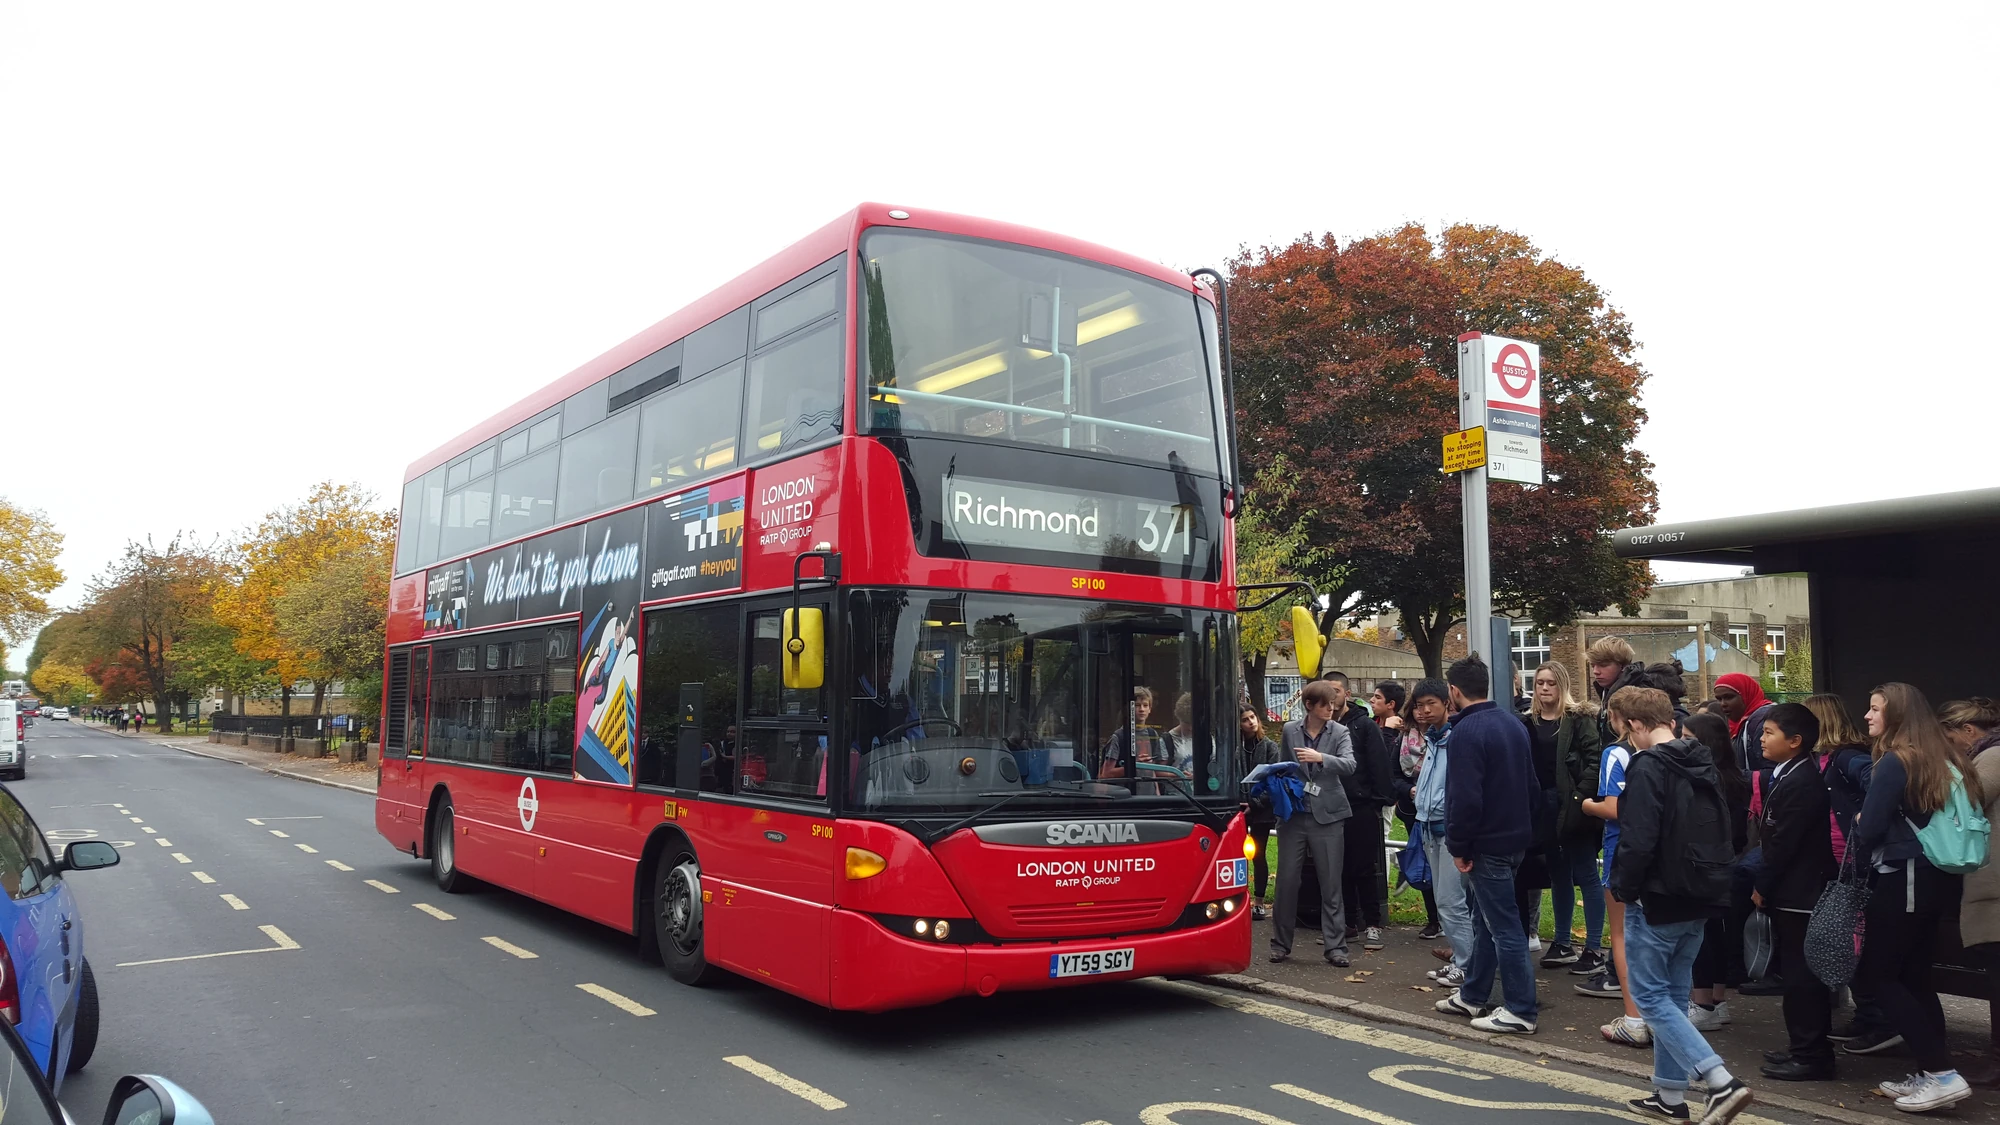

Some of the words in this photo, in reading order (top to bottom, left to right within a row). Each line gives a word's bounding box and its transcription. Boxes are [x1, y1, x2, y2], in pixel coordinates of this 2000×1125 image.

[1502, 366, 1514, 374] BUS
[1514, 368, 1528, 376] STOP
[1492, 417, 1525, 428] Ashburnham
[1525, 422, 1537, 430] Road
[1446, 446, 1455, 454] No
[1457, 440, 1481, 452] stopping
[1504, 444, 1529, 455] Richmond
[1455, 452, 1466, 461] any
[1468, 449, 1481, 457] time
[1445, 461, 1464, 470] except
[1467, 457, 1484, 466] buses
[1492, 462, 1505, 471] 371
[761, 475, 815, 506] LONDON
[760, 500, 813, 529] UNITED
[953, 490, 1099, 538] Richmond
[760, 532, 778, 546] RATP
[789, 525, 813, 540] GROUP
[1136, 502, 1190, 556] 371
[1631, 534, 1654, 544] 0127
[1658, 532, 1685, 542] 0057
[484, 556, 505, 606] We
[505, 551, 542, 601] don't
[541, 548, 560, 595] tie
[559, 554, 590, 609] you
[591, 526, 639, 586] down
[651, 564, 697, 589] giffgaff.com
[700, 557, 737, 577] #heyyou
[1071, 576, 1106, 591] SP100
[678, 806, 689, 818] FW
[811, 823, 834, 839] SP100
[1045, 823, 1140, 845] SCANIA
[1017, 860, 1086, 877] LONDON
[1093, 858, 1156, 874] UNITED
[1055, 878, 1080, 888] RATP
[1093, 876, 1121, 886] GROUP
[1061, 953, 1101, 974] YT59
[1104, 950, 1133, 970] SGY
